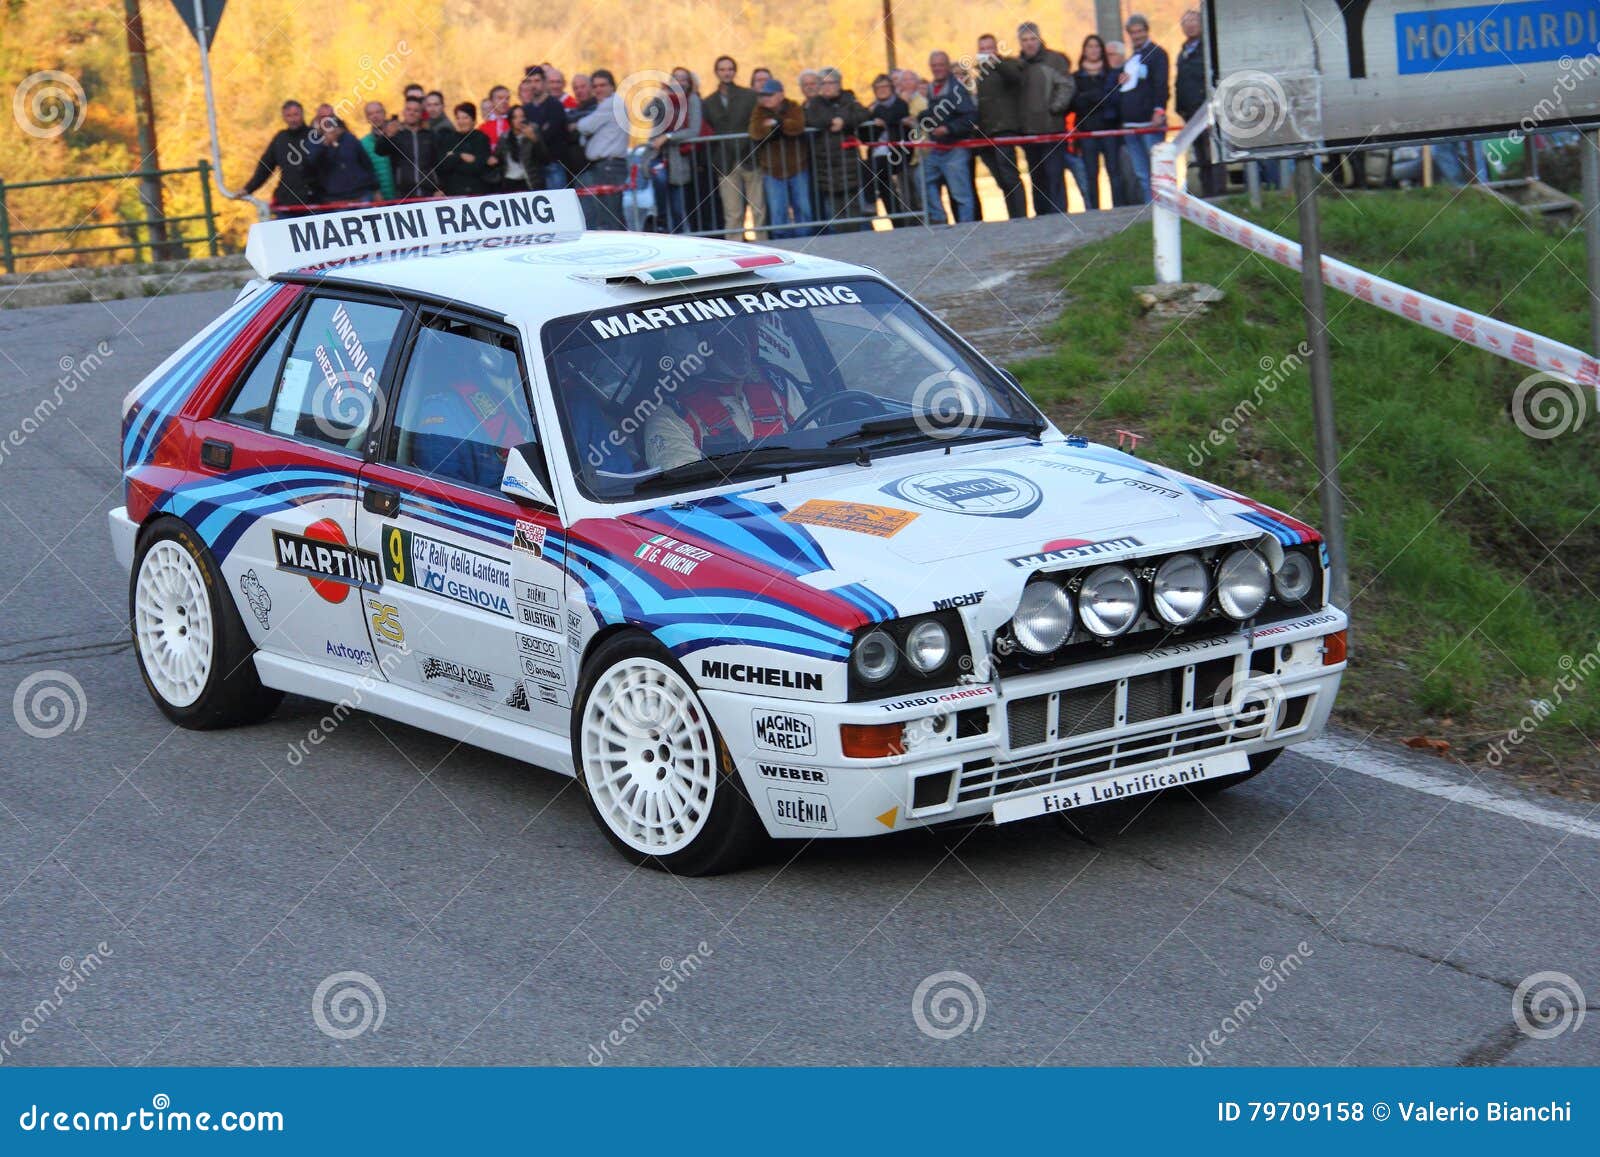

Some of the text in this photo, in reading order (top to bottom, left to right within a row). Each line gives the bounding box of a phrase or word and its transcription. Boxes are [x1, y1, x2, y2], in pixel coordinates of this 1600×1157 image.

[1405, 10, 1597, 61] MONGIARDI
[288, 195, 555, 253] MARTINI RACING
[590, 285, 861, 340] MARTINI RACING
[331, 303, 376, 394] VINCINI G.
[315, 345, 338, 390] GHEZZI
[937, 479, 1006, 498] LANCIA
[278, 538, 379, 586] MARTINI
[389, 528, 405, 583] 9
[429, 543, 449, 574] Rally
[450, 549, 471, 576] della
[472, 556, 510, 589] Lanterna
[648, 548, 699, 576] G. VINCINI
[674, 543, 715, 562] GHEZZI
[1015, 538, 1137, 568] MARTINI
[447, 580, 511, 614] GENOVA
[523, 608, 557, 629] BILSTEIN
[1291, 614, 1337, 631] TURBO
[521, 635, 556, 656] sparco
[535, 662, 561, 680] brembo
[701, 659, 823, 691] MICHELIN
[880, 686, 993, 712] TURBO GARRET
[756, 715, 812, 741] MAGNETI
[758, 764, 825, 783] WEBER
[1042, 763, 1205, 812] Fiat Lubrificanti
